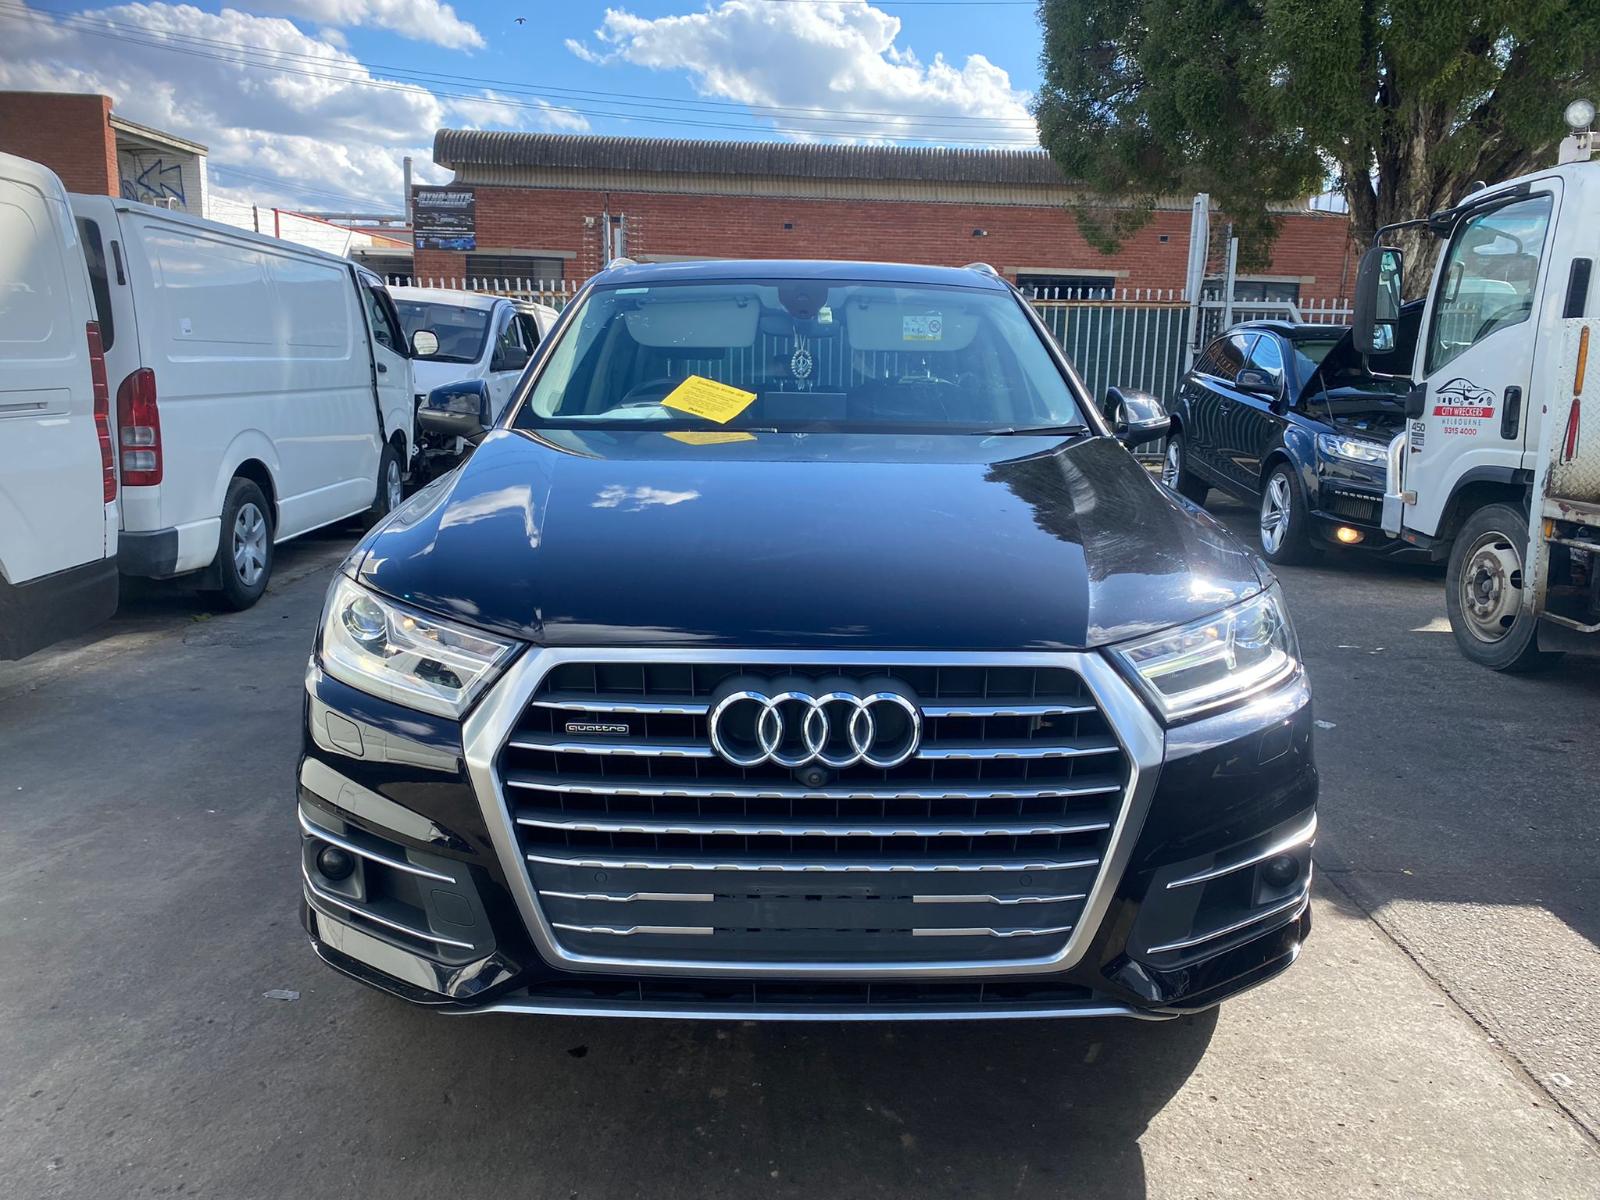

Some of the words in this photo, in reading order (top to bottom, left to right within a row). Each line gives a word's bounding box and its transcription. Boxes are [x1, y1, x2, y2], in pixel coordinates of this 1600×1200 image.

[1441, 407, 1453, 416] CITY
[1453, 407, 1483, 416] WRECKERS
[1442, 418, 1481, 426] MELBOURNE
[1411, 423, 1425, 432] 450
[1460, 428, 1477, 436] 4000
